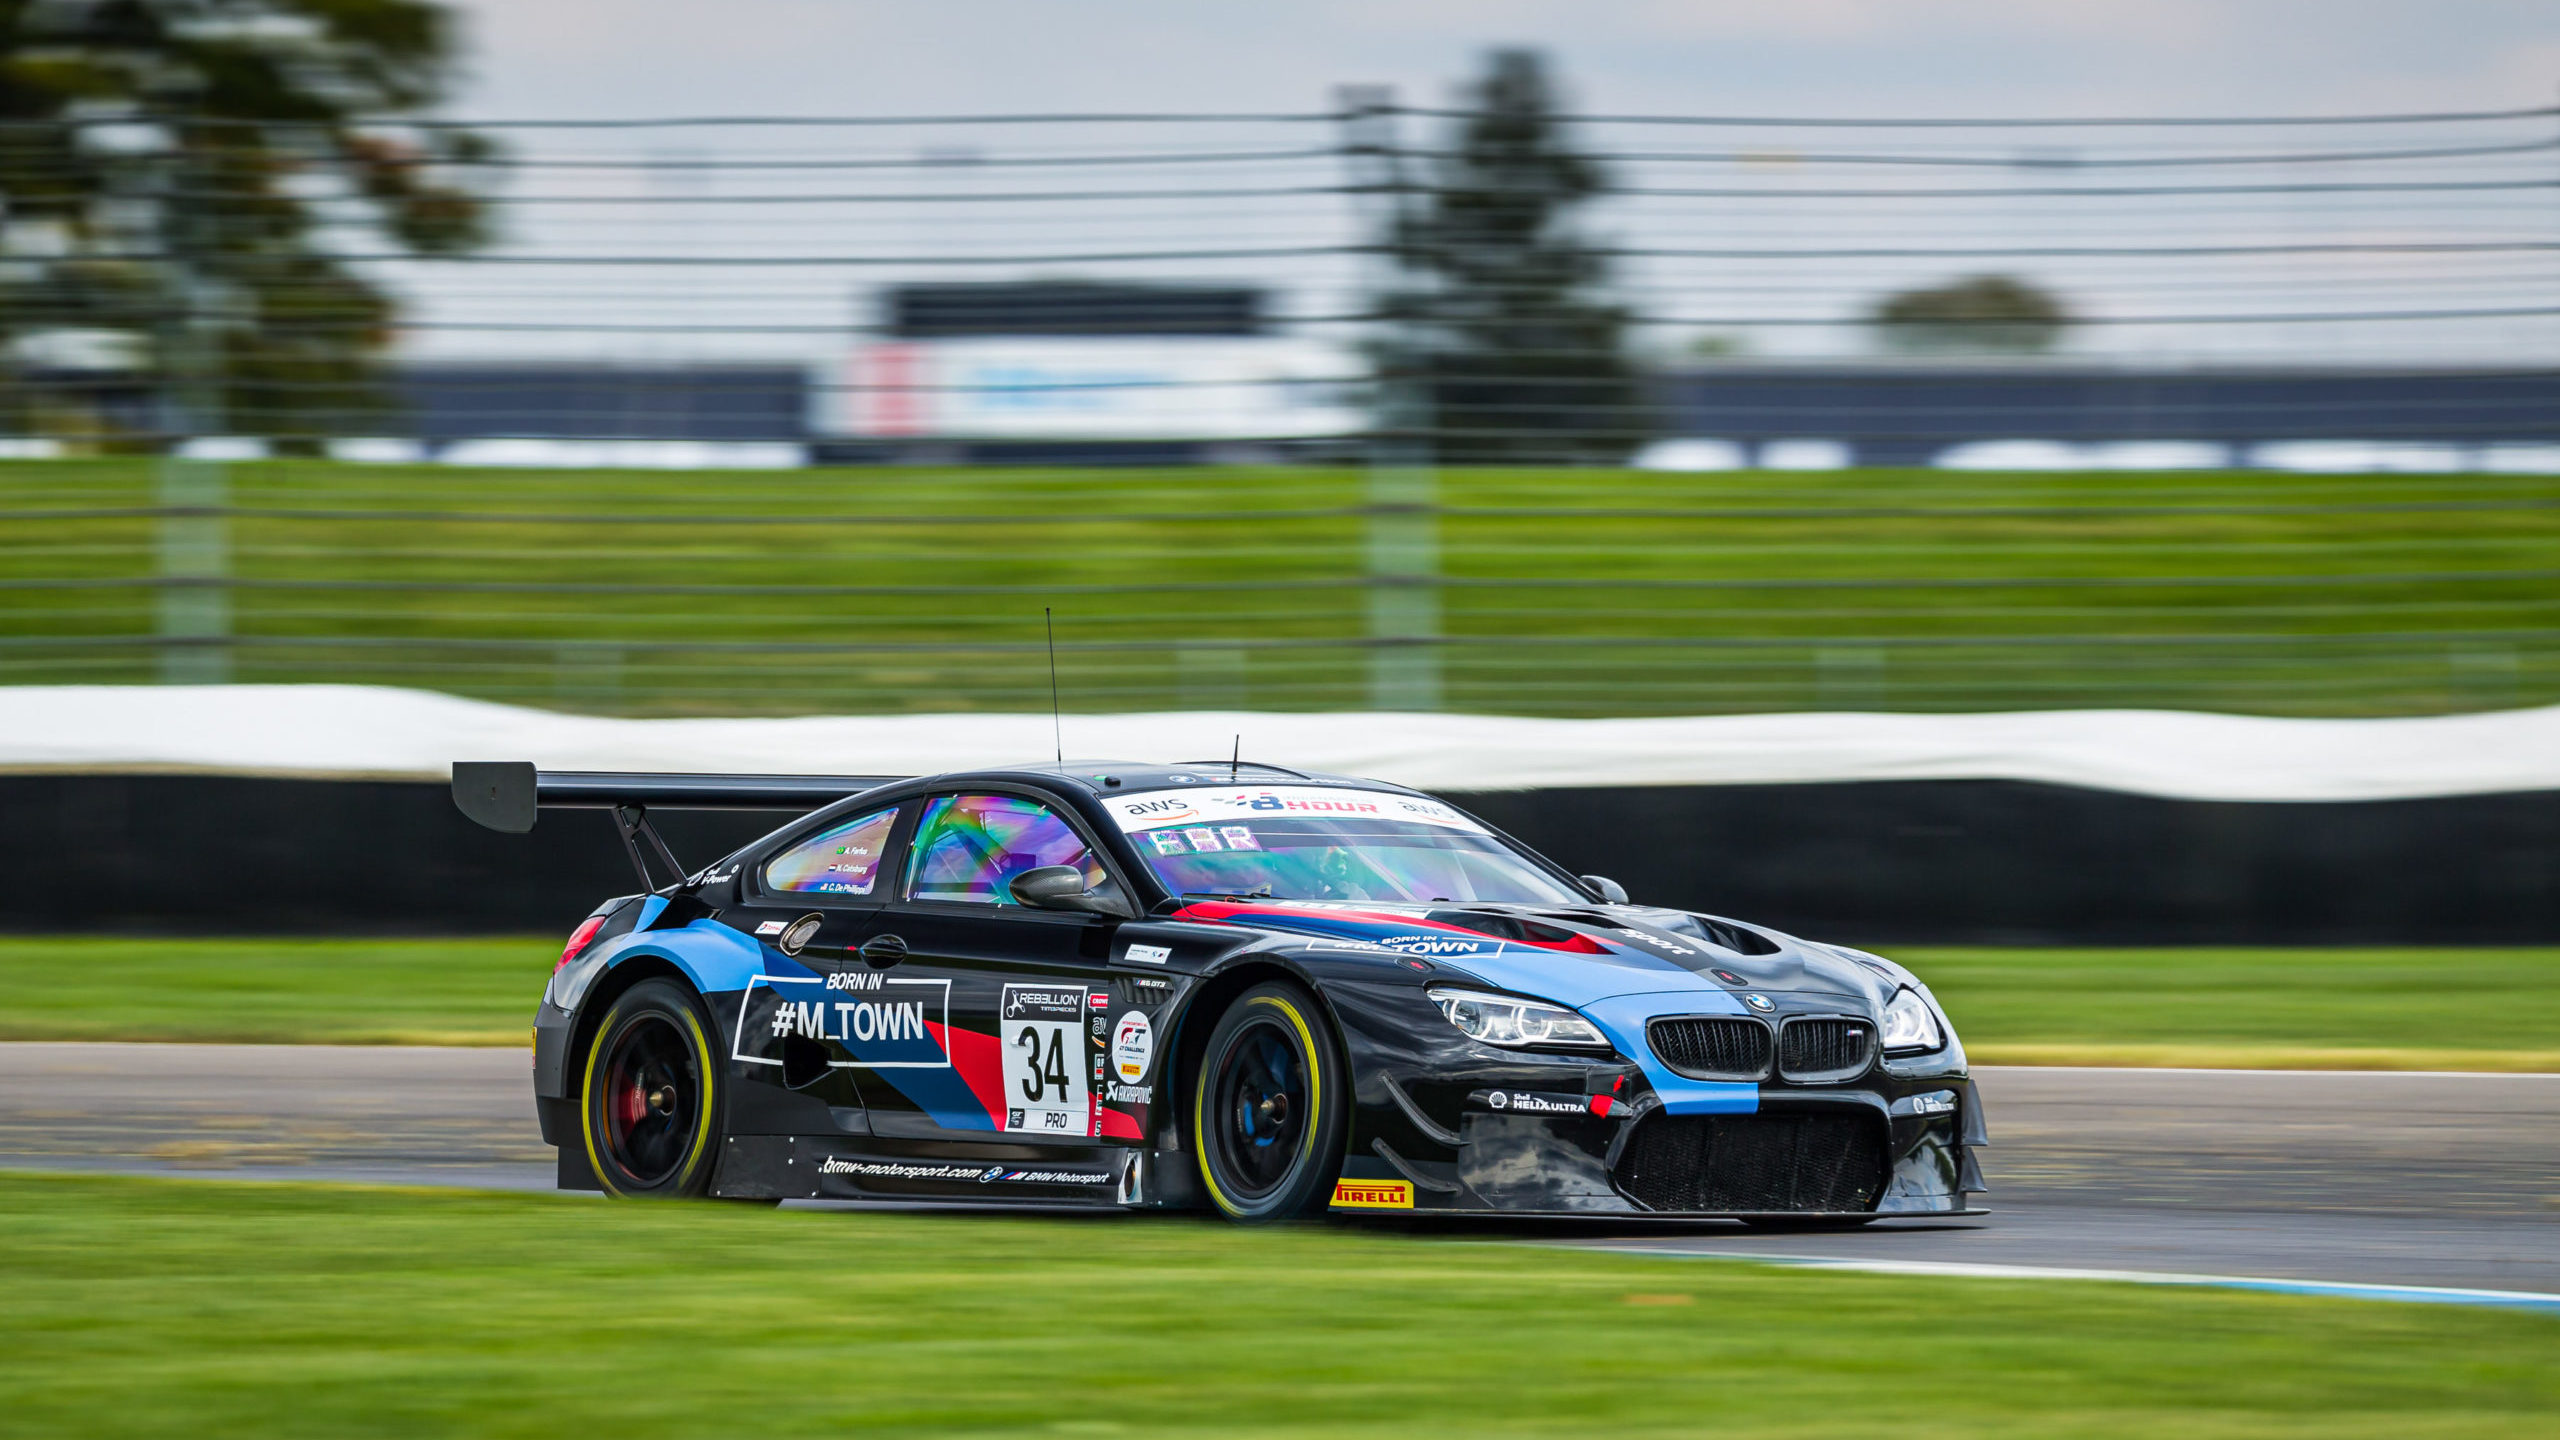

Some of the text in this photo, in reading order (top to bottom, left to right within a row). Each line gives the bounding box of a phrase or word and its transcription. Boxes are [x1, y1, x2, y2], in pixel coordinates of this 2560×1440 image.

[1125, 798, 1188, 815] aws
[1286, 801, 1379, 813] HOUR
[1382, 935, 1415, 944] BORN
[826, 973, 884, 990] BORN IN
[1019, 992, 1078, 1006] REBELLION
[771, 1001, 924, 1042] #M_TOWN
[1018, 1025, 1070, 1103] 34
[1513, 1097, 1586, 1113] HELIX ULTRA
[1044, 1112, 1068, 1128] PRO
[1025, 1172, 1056, 1182] BMW
[1053, 1173, 1110, 1184] Motorsport
[1336, 1184, 1406, 1203] PIRELLI
